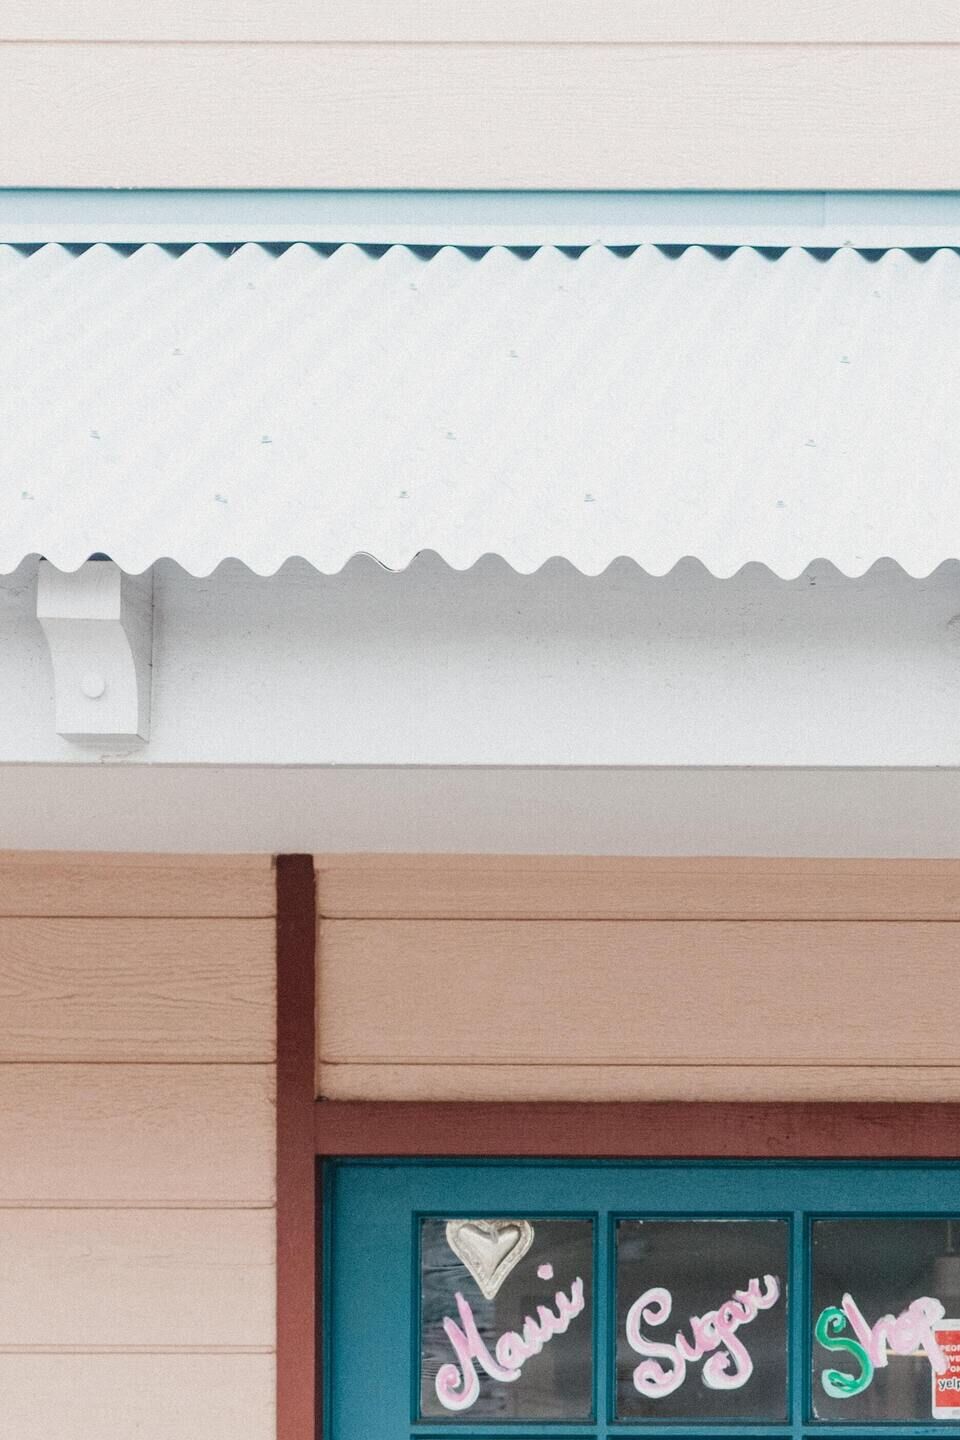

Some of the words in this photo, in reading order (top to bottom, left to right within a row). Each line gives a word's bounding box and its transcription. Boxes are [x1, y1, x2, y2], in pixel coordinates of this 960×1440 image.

[435, 1263, 585, 1411] Maui
[626, 1274, 780, 1398] Sugar
[815, 1292, 947, 1399] Shop
